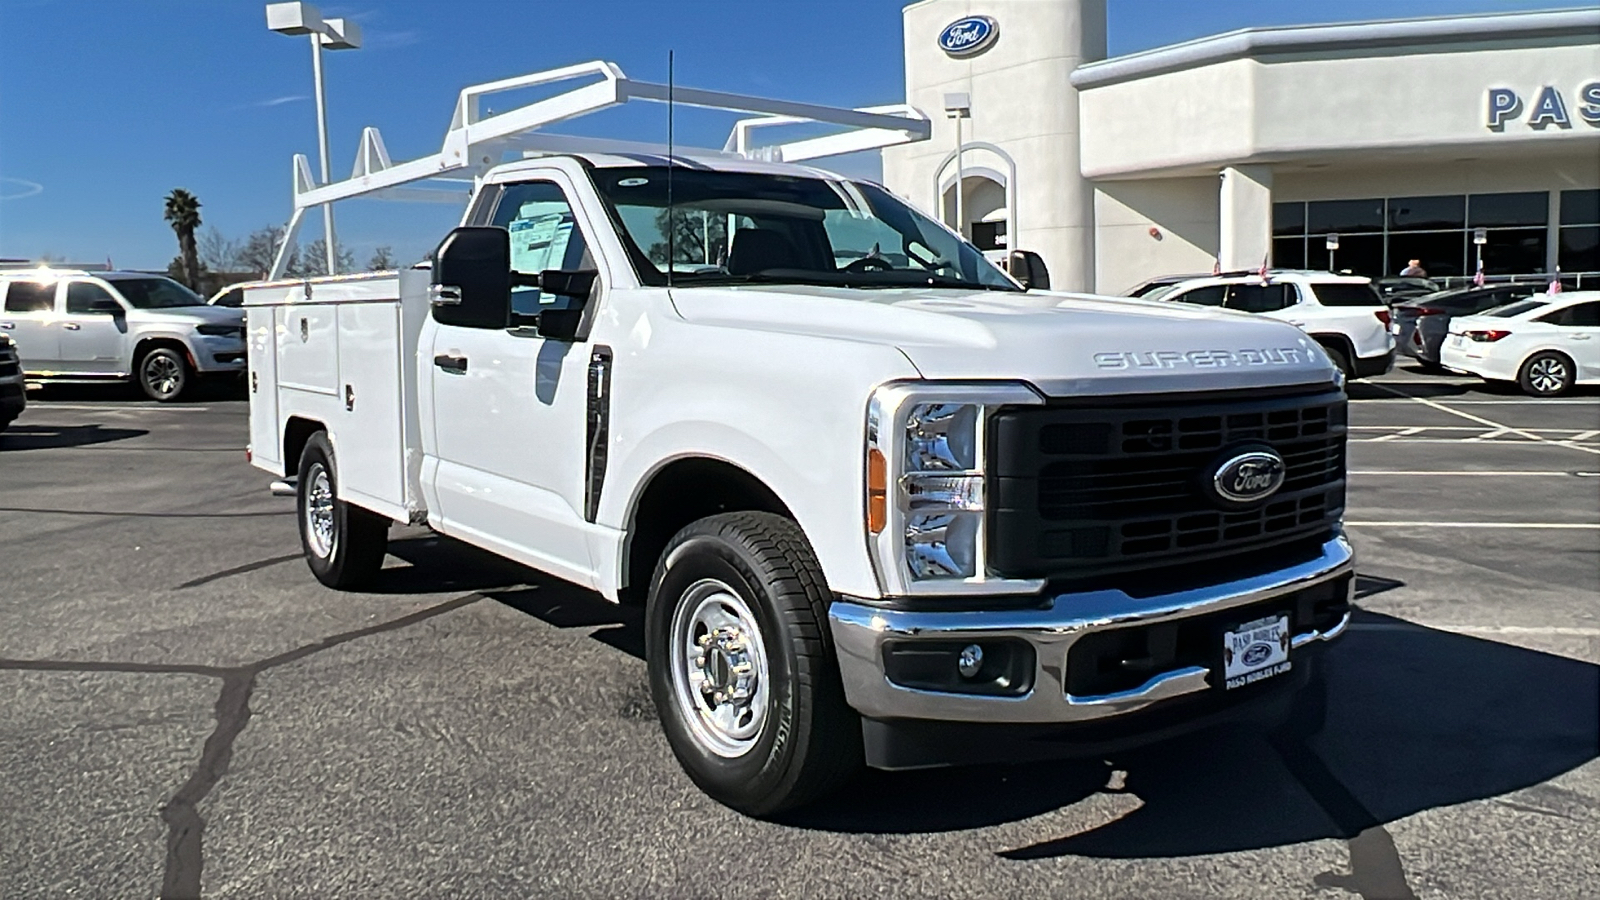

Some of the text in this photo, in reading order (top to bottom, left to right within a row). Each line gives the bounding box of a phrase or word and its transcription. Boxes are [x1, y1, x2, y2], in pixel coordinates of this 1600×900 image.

[946, 23, 979, 47] Ford
[1093, 350, 1241, 370] SUPER
[1234, 463, 1273, 491] Ford
[1226, 676, 1246, 690] PASO
